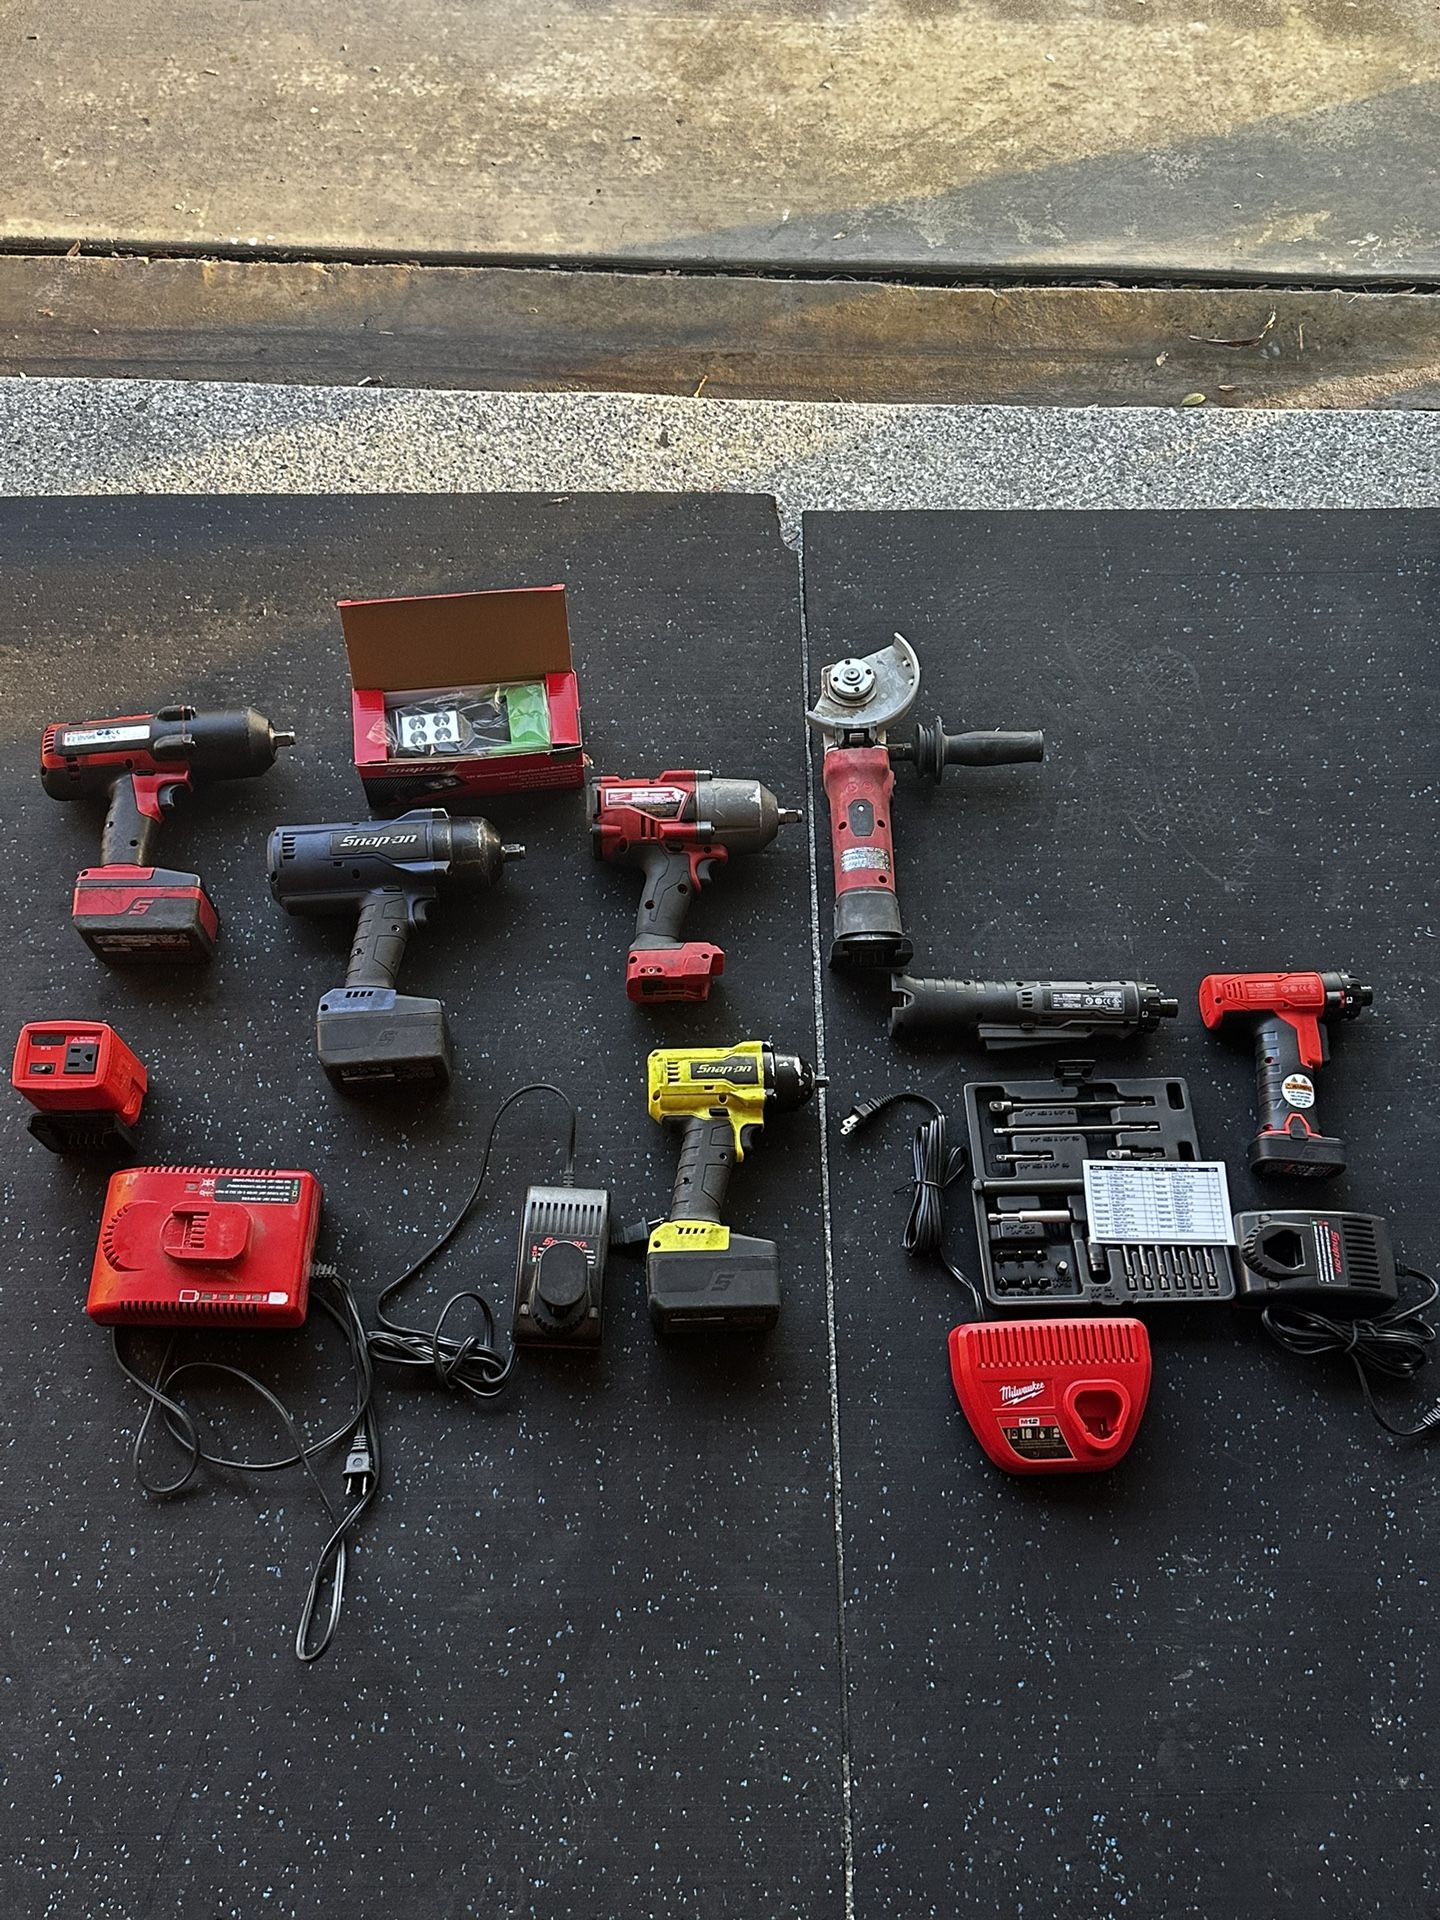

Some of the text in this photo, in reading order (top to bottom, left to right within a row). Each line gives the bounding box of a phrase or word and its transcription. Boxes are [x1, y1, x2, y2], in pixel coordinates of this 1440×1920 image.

[340, 834, 417, 848] Snap-on
[697, 1064, 752, 1074] Snap-on
[999, 1381, 1045, 1401] Milwaukee
